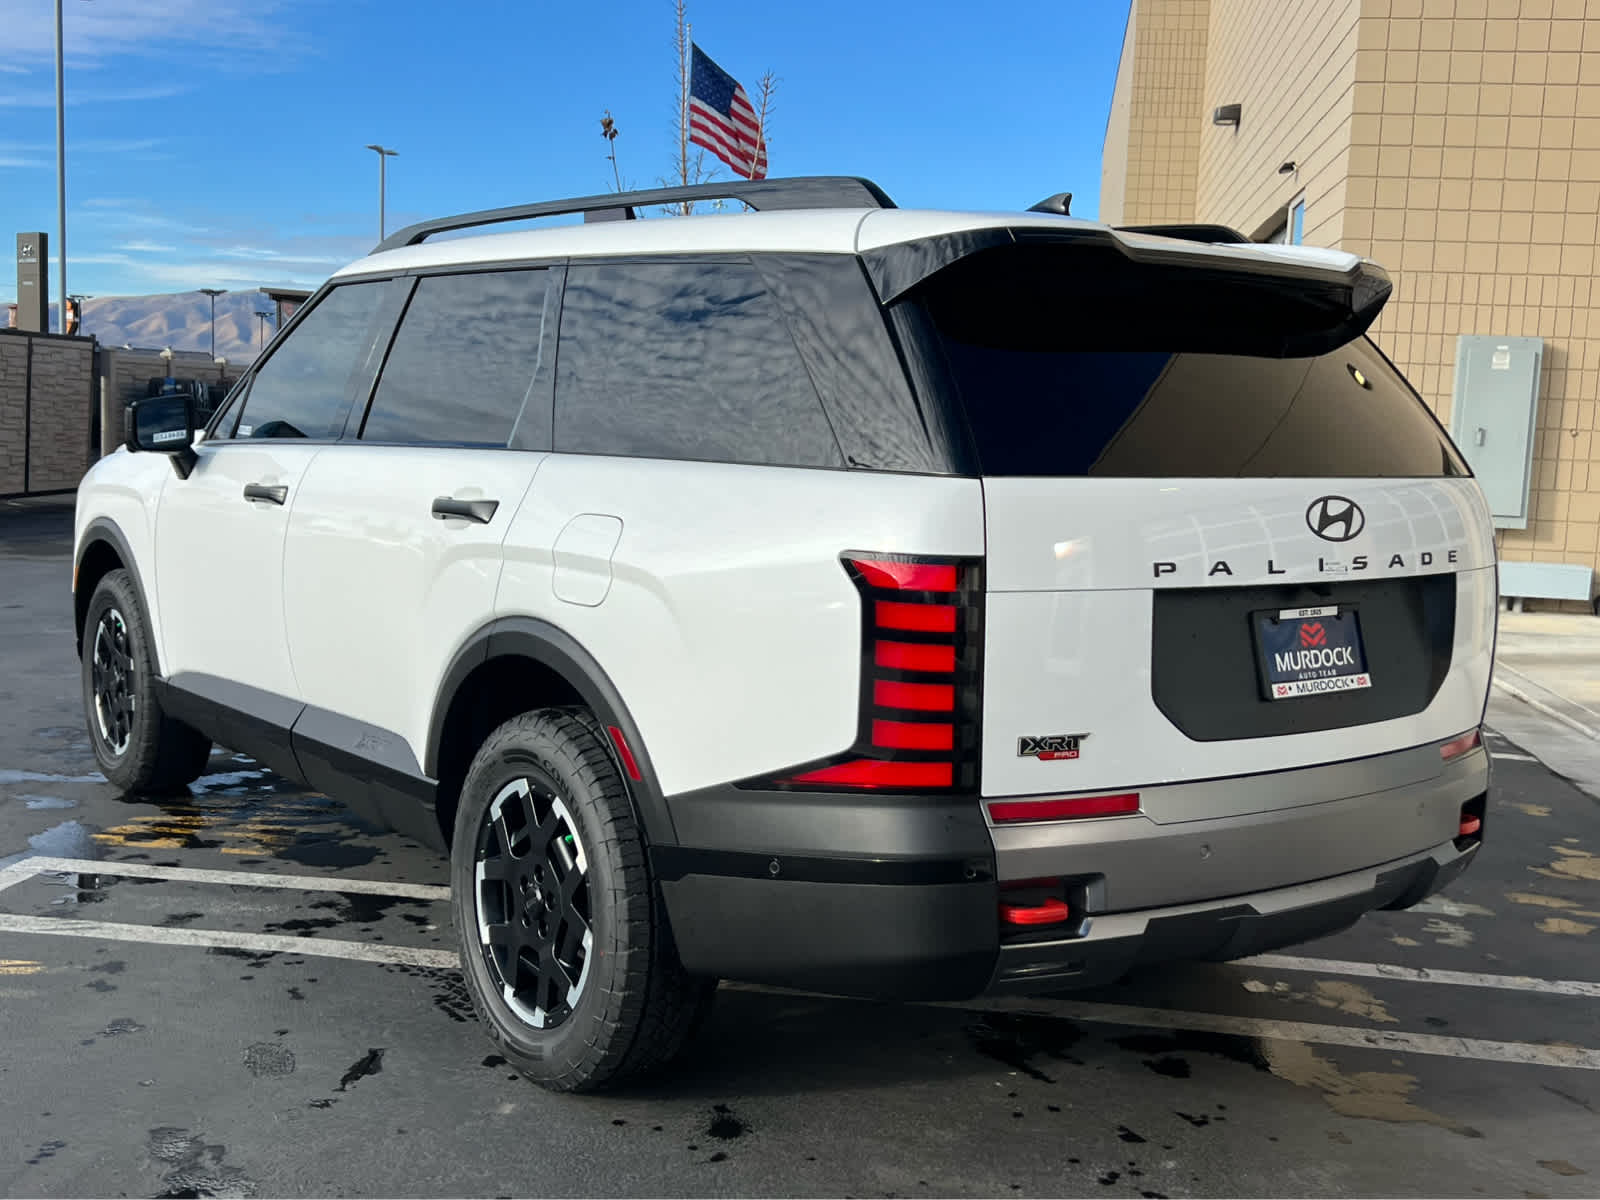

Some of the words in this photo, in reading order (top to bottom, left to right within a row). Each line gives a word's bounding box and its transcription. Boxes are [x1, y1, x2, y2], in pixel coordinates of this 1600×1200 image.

[1153, 550, 1458, 577] PALISADE
[1275, 646, 1354, 672] MURDOCK
[1299, 671, 1317, 679] AUTO
[1319, 669, 1337, 677] TEAM
[1296, 678, 1350, 693] MURDOCK
